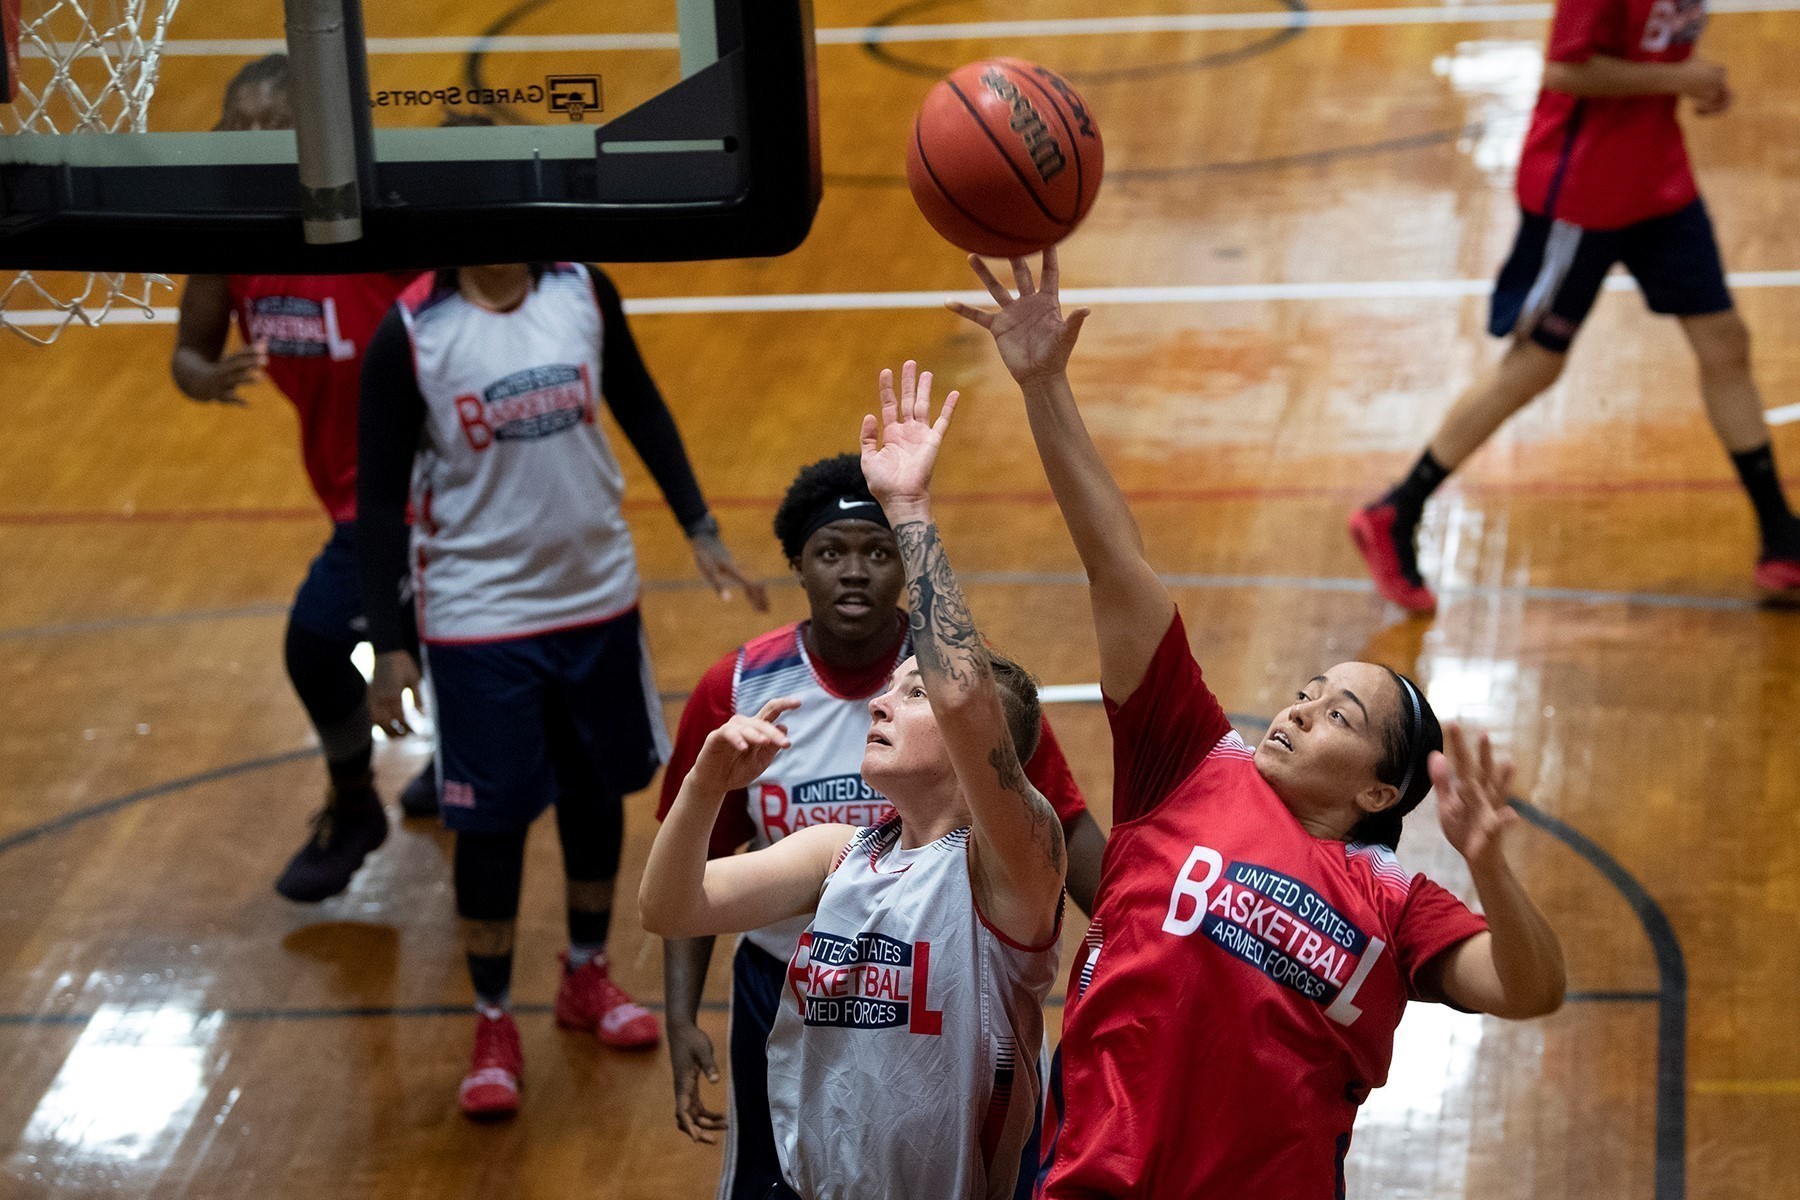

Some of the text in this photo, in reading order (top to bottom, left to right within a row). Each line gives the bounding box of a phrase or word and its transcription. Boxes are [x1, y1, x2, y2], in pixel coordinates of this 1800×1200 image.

[801, 777, 858, 802] UNITED
[1236, 867, 1356, 949] UNITED STATES
[848, 937, 902, 963] STATES
[1162, 845, 1386, 1028] BASKETBALL
[1212, 920, 1326, 999] ARMED FORCES
[804, 1000, 897, 1024] MED FORCES
